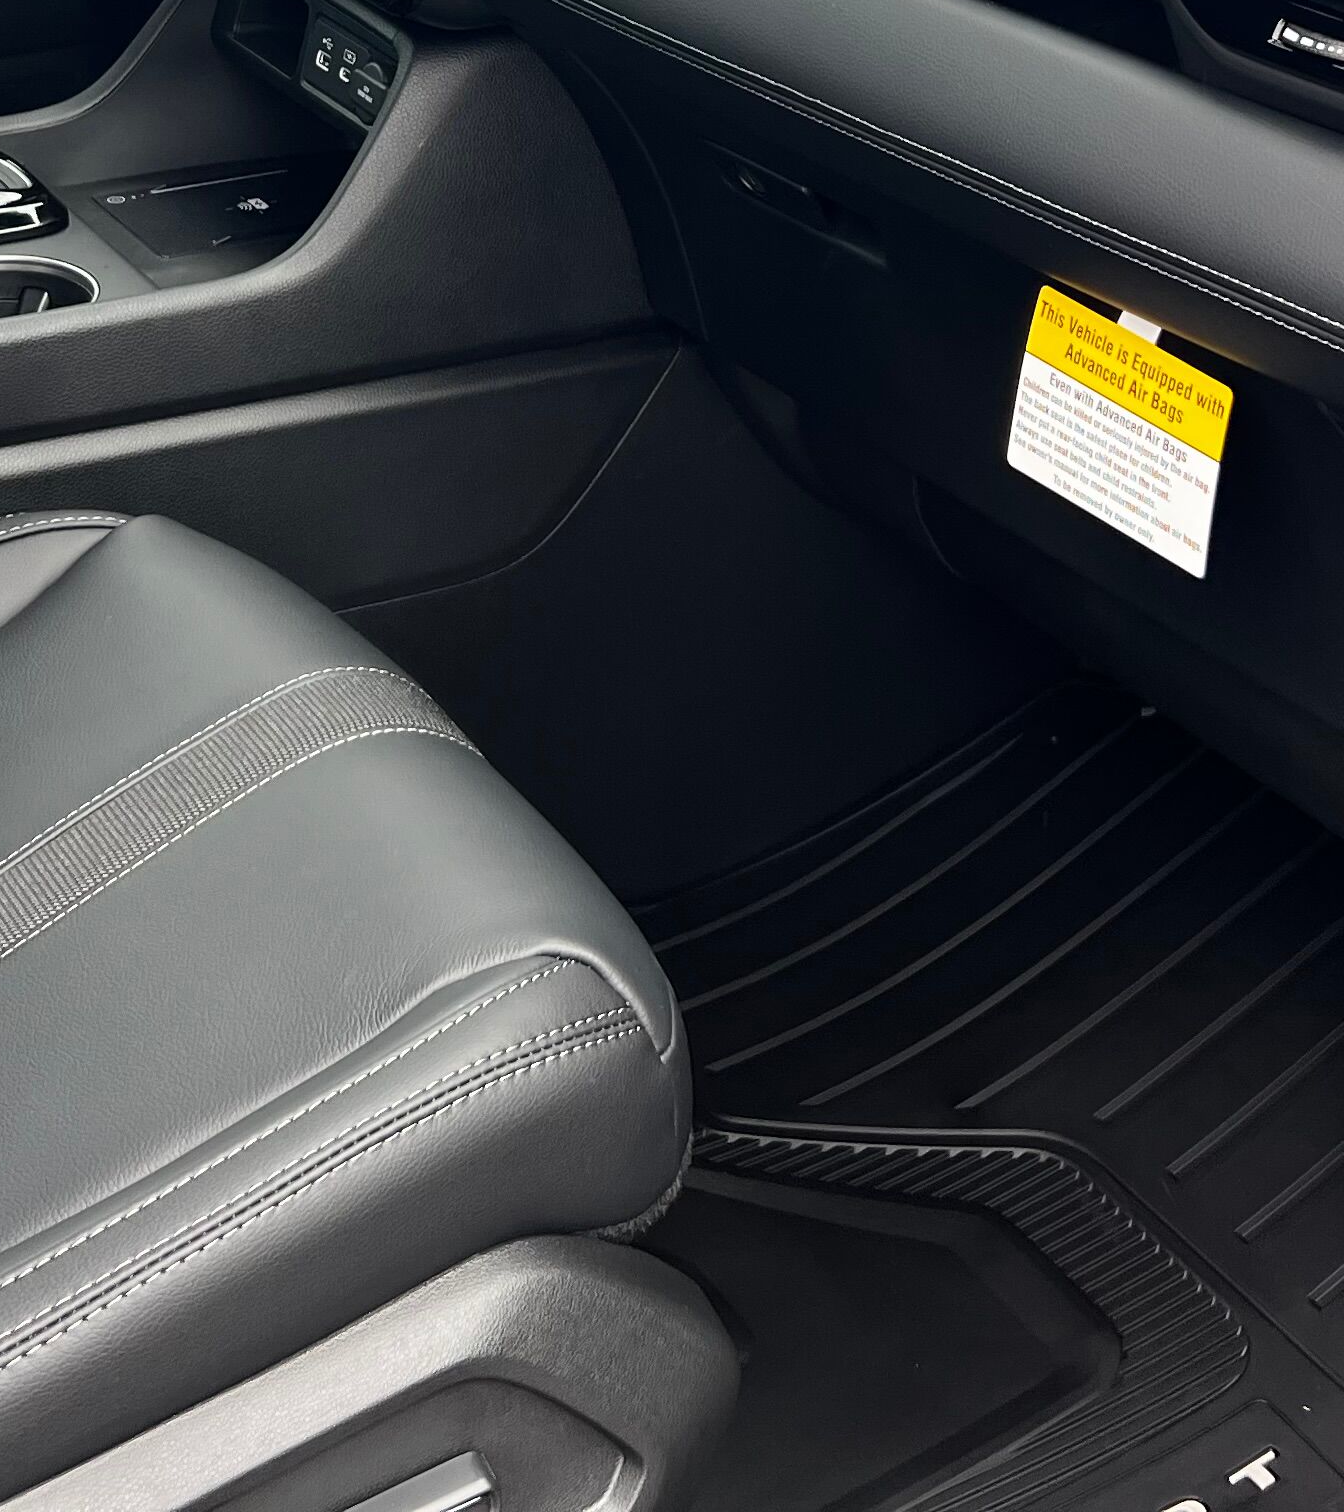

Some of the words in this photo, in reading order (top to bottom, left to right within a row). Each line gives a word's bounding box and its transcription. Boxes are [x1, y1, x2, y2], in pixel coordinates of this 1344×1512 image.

[1040, 299, 1065, 329] This
[1069, 315, 1114, 356] Vehicle
[1116, 344, 1129, 365] is
[1131, 352, 1193, 401] Equipped
[1196, 392, 1225, 419] with
[1064, 343, 1126, 391] Advanced
[1127, 379, 1149, 403] Air
[1150, 391, 1184, 424] Bags
[1015, 419, 1039, 441] Always
[1053, 443, 1069, 458] seat
[1069, 451, 1087, 469] belts
[1087, 463, 1102, 477] and
[1102, 472, 1120, 488] child
[1018, 404, 1038, 424] Never
[1038, 418, 1050, 431] put
[1056, 429, 1094, 459] rear-facing
[1094, 452, 1113, 468] child
[1112, 462, 1129, 478] seat
[1129, 471, 1137, 482] in
[1138, 475, 1150, 490] the
[1021, 390, 1033, 405] The
[1033, 398, 1050, 415] back
[1050, 410, 1066, 425] seat
[1066, 419, 1073, 430] is
[1073, 422, 1085, 436] the
[1085, 431, 1108, 449] safest
[1108, 444, 1128, 461] place
[1129, 454, 1140, 468] for
[1049, 372, 1072, 395] Even
[1074, 389, 1094, 409] with
[1095, 400, 1143, 437] Advanced
[1144, 428, 1161, 446] Air
[1162, 437, 1188, 463] Bags
[1050, 394, 1063, 408] can
[1063, 400, 1073, 413] be
[1073, 407, 1093, 425] killed
[1093, 419, 1102, 429] or
[1101, 424, 1133, 450] seriously
[1159, 456, 1170, 471] by
[1170, 462, 1182, 477] the
[1182, 471, 1194, 483] air
[1013, 433, 1027, 449] See
[1079, 472, 1090, 485] for
[1090, 480, 1109, 497] more
[1109, 491, 1150, 521] information
[1150, 516, 1171, 533] about
[1171, 528, 1183, 540] air
[1053, 473, 1062, 487] To
[1062, 479, 1072, 493] be
[1072, 487, 1103, 511] removed
[1104, 504, 1114, 519] by
